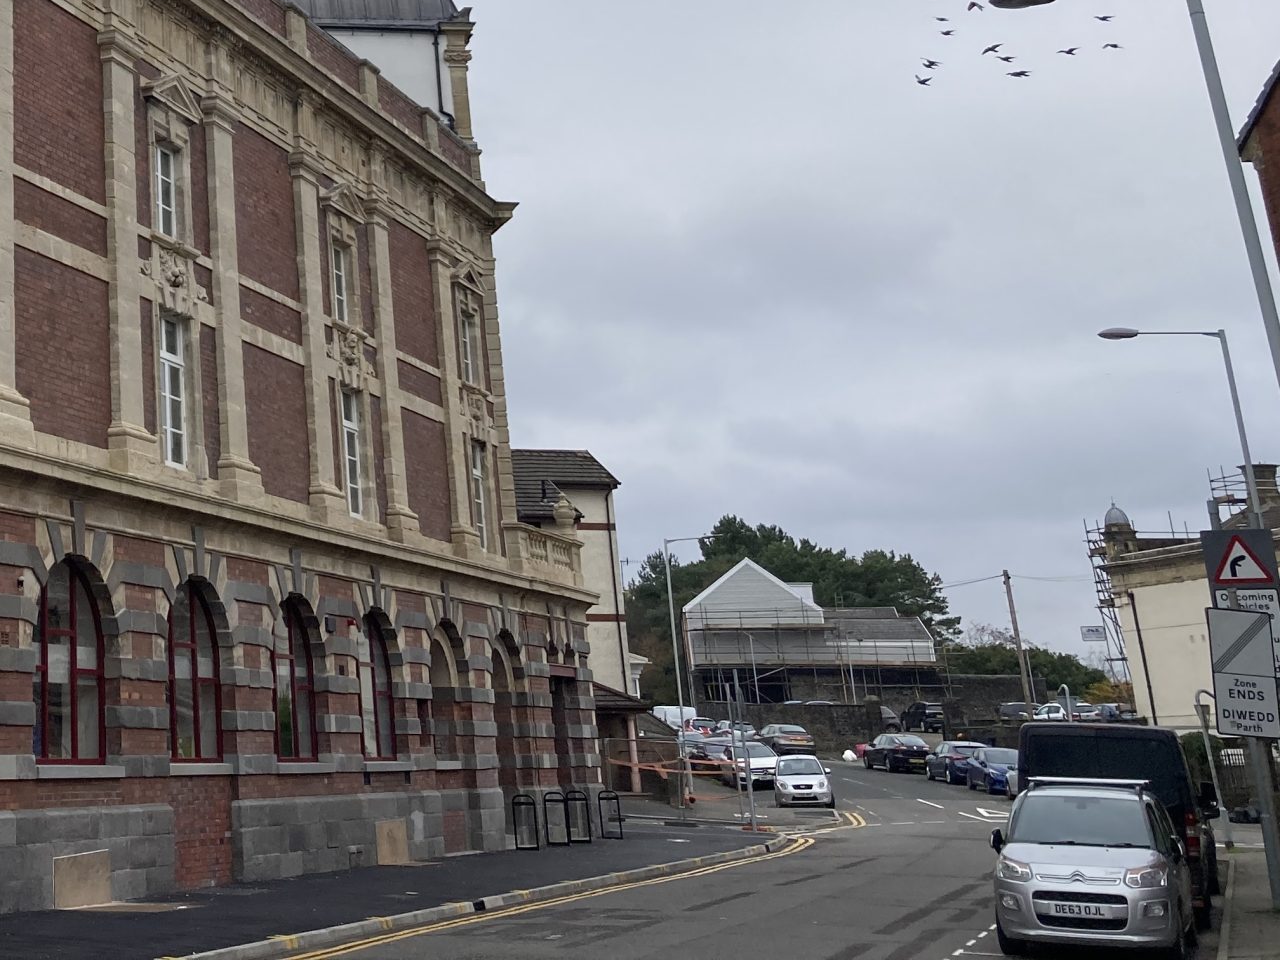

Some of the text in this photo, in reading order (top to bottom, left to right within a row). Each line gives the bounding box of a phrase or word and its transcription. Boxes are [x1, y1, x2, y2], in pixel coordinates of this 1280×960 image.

[1221, 592, 1274, 602] Ocoming
[1233, 678, 1257, 688] Zone
[1228, 688, 1265, 701] ENDS
[1222, 708, 1275, 723] DIWEDD
[1236, 722, 1263, 733] Parth
[1054, 904, 1082, 915] DE63
